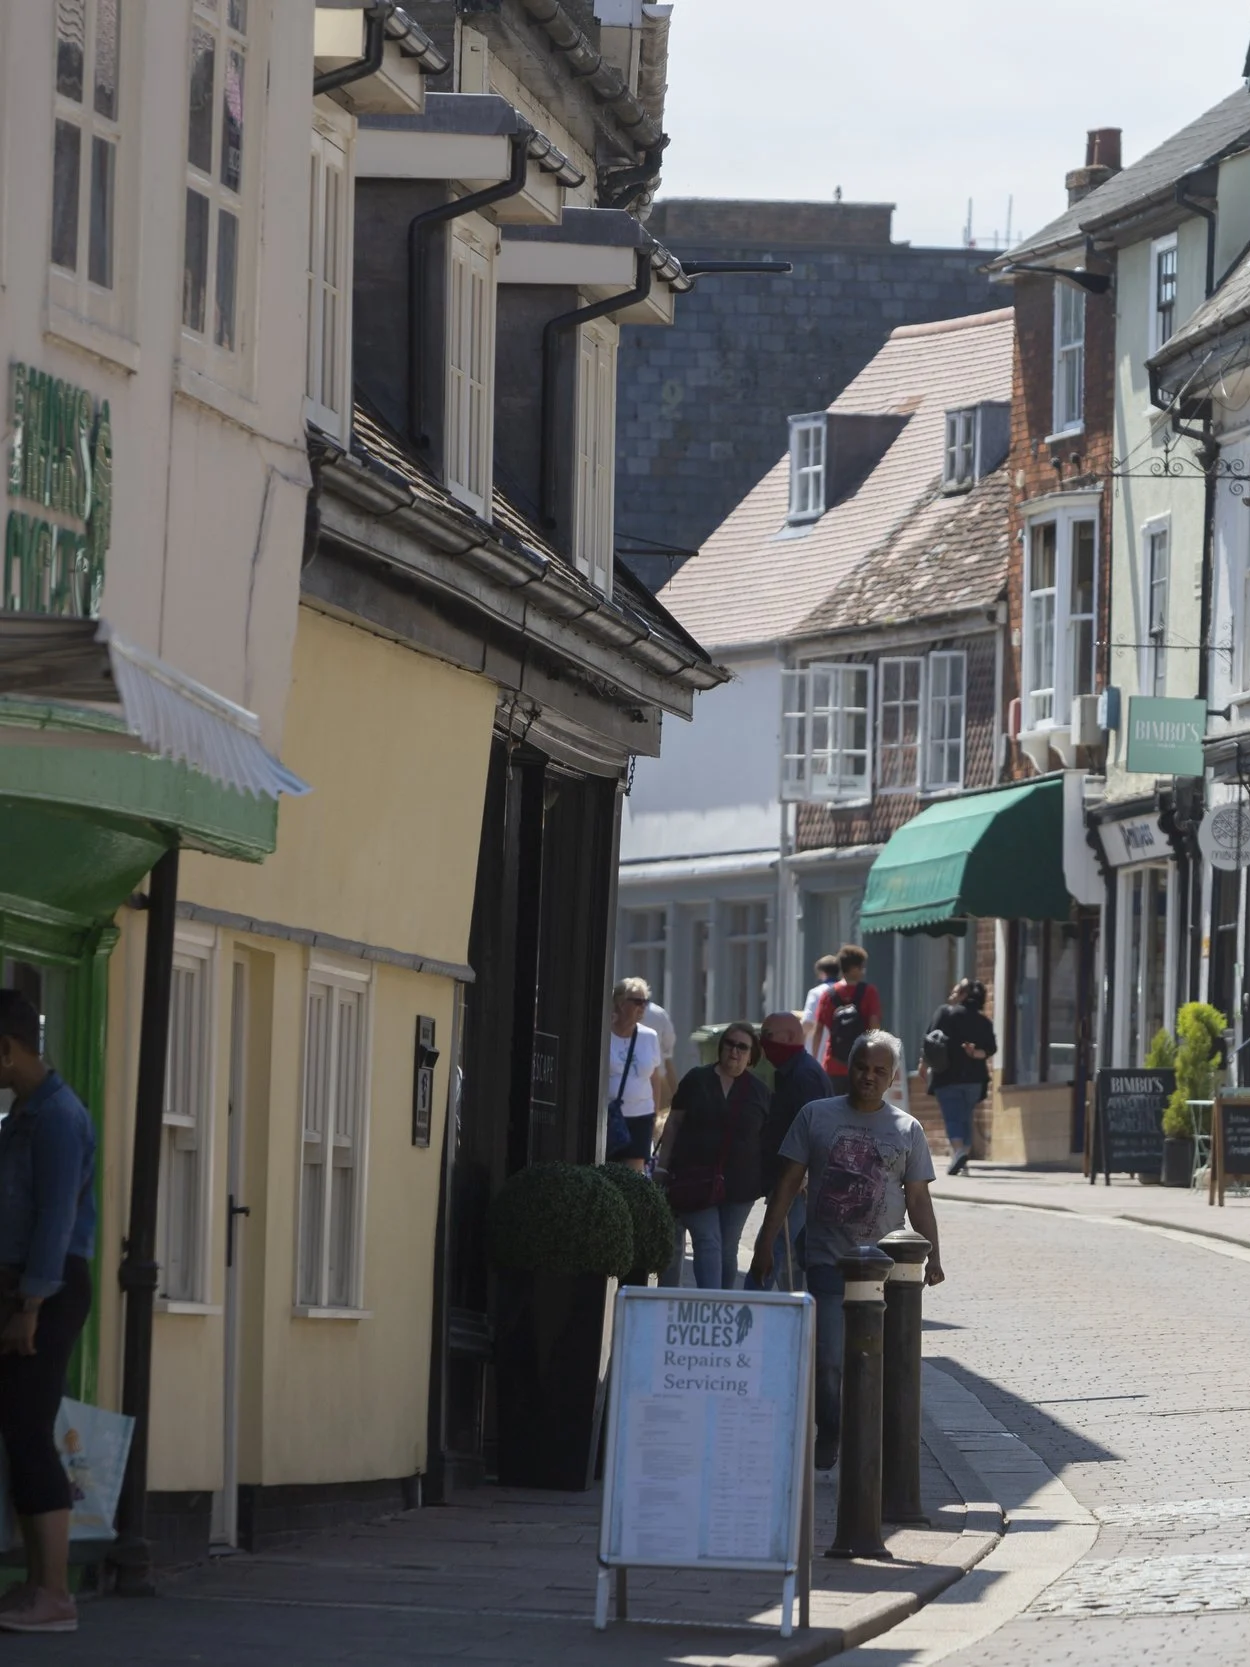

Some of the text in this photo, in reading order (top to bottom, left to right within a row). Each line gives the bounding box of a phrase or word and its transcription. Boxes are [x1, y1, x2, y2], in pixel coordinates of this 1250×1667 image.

[1135, 720, 1200, 742] BIMBO'S
[1110, 1077, 1164, 1094] BIMBO'S
[678, 1301, 734, 1325] MICKS
[666, 1324, 734, 1348] CYCLES
[664, 1350, 752, 1372] Repairs &
[663, 1373, 749, 1397] Servicing
